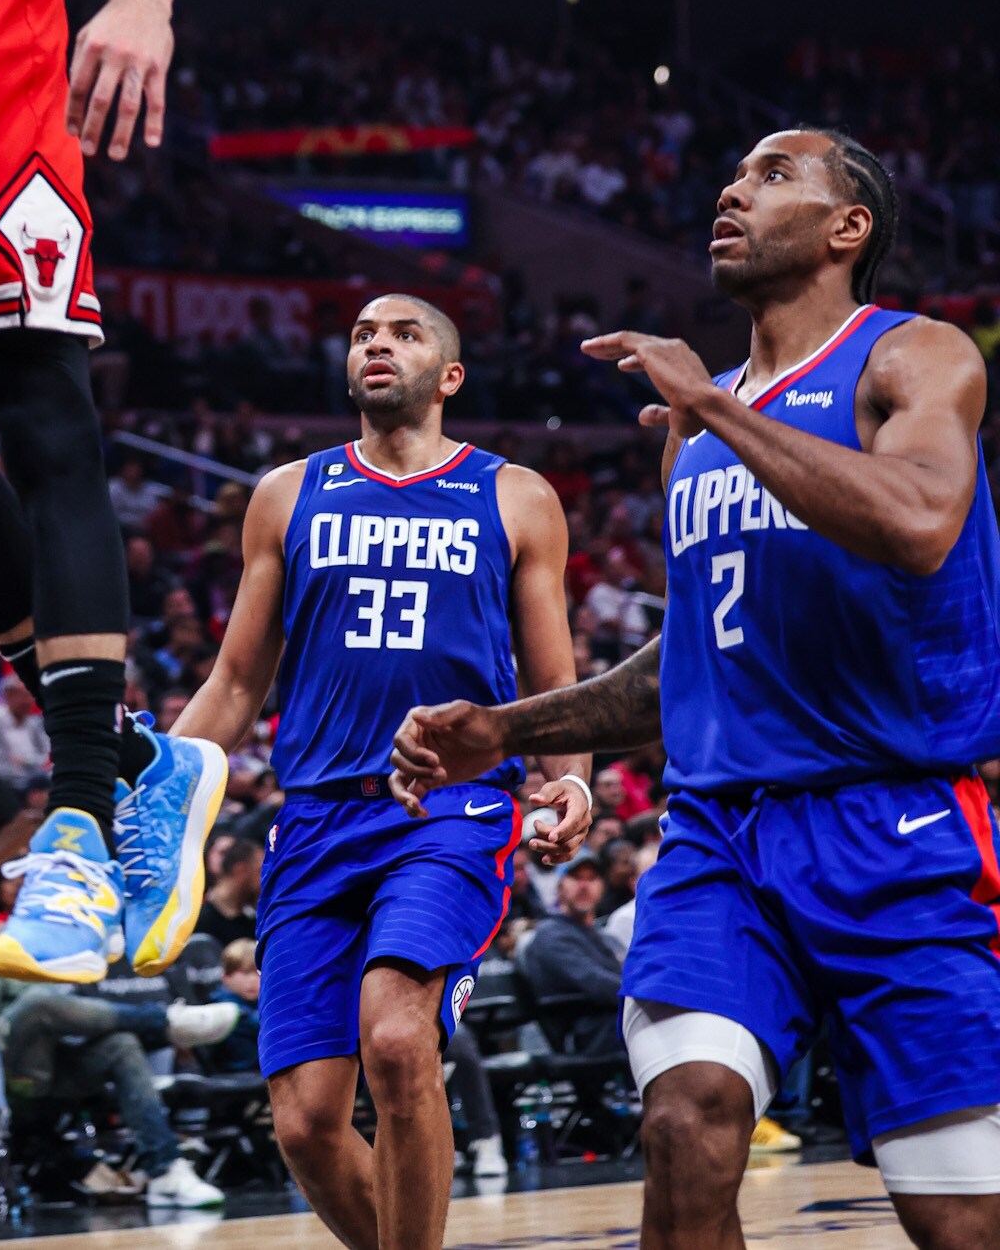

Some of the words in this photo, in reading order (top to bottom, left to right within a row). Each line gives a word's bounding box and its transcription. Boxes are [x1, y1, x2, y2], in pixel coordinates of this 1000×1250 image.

[785, 389, 833, 409] honey
[327, 463, 345, 476] 6
[436, 479, 480, 493] honey
[668, 463, 810, 558] CLIPPER
[309, 512, 480, 576] CLIPPERS
[345, 577, 429, 650] 33
[711, 550, 745, 650] 2
